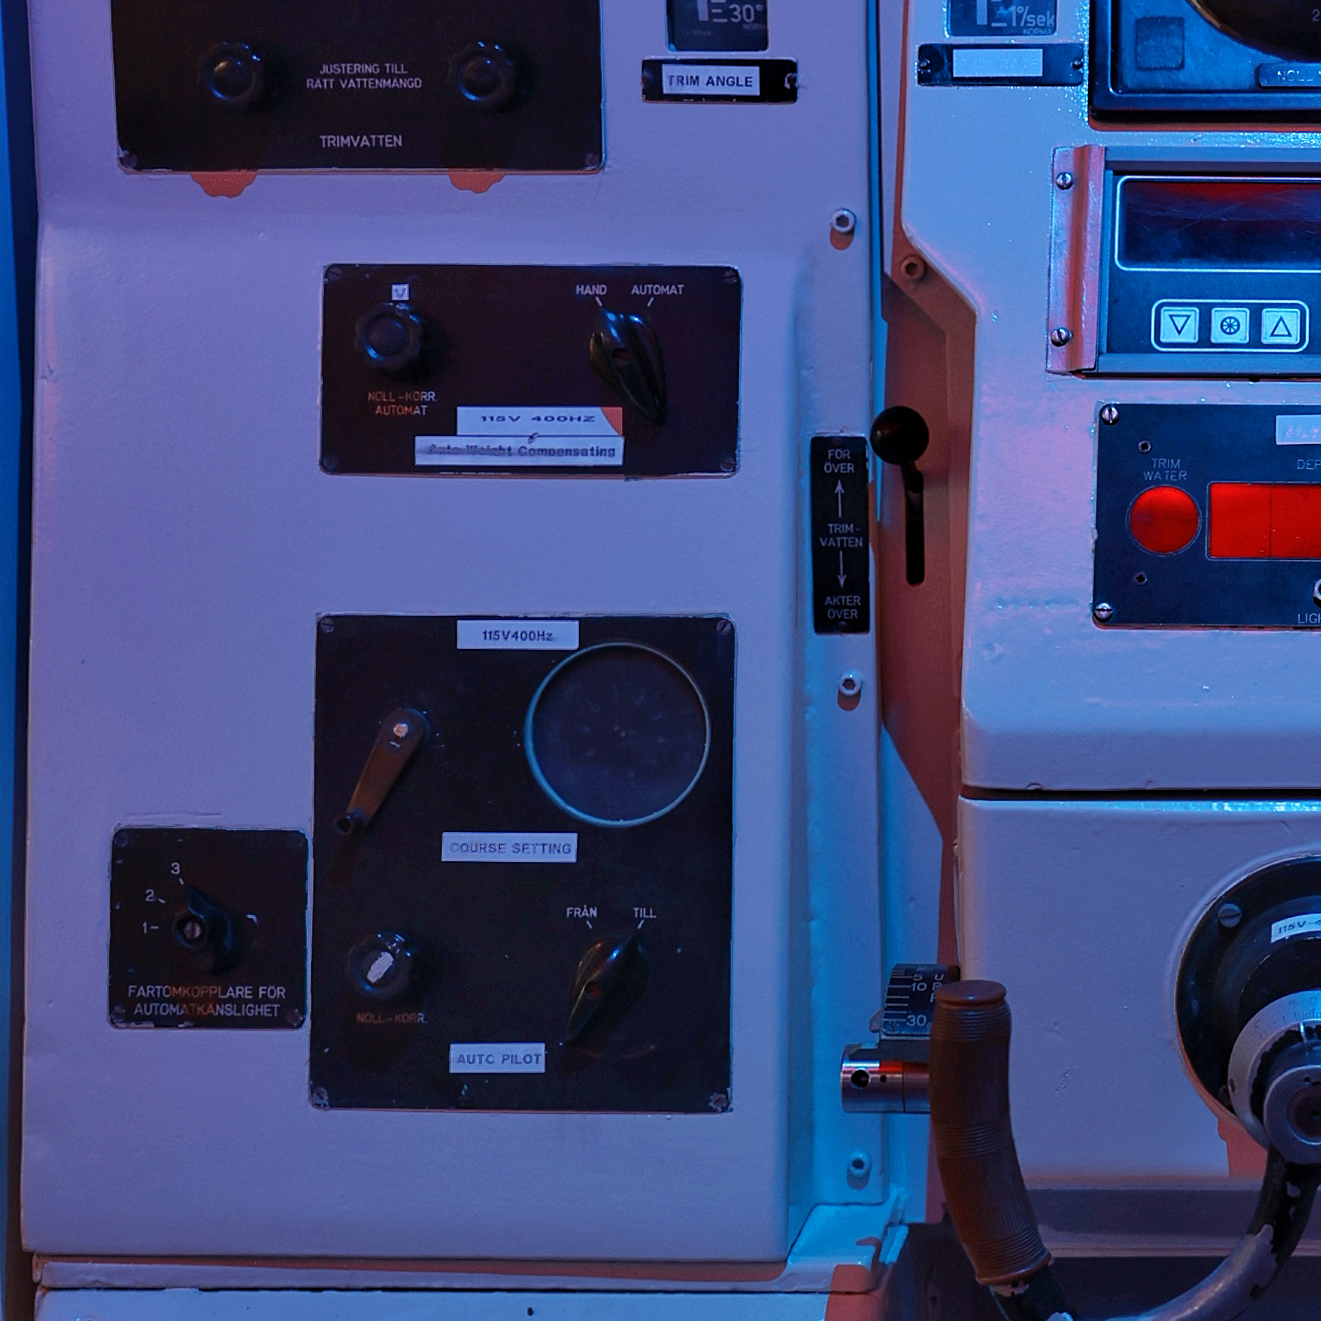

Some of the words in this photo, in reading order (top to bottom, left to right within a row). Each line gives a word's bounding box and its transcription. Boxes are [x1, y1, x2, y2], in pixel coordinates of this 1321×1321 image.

[320, 63, 381, 75] JUSTERING
[384, 63, 408, 74] TILL
[667, 74, 700, 87] TRIM
[705, 75, 753, 88] ANGLE
[319, 134, 402, 148] TRIMVATTEN
[576, 284, 607, 295] HAND
[631, 284, 684, 295] AUTOMAT
[375, 405, 428, 416] AUTOMAT
[530, 415, 596, 423] 400HZ
[518, 446, 616, 458] Compensating
[1151, 458, 1181, 469] TRIM
[1143, 470, 1187, 482] WATER
[819, 537, 863, 548] VATTEN
[824, 595, 862, 607] AKTER
[482, 630, 553, 642] 115V400Hz
[449, 842, 507, 854] COURSE
[511, 842, 572, 855] SETTING
[171, 861, 181, 874] 3
[145, 889, 156, 902] 2
[566, 904, 598, 919] FRÅN
[633, 907, 657, 919] TILL
[128, 985, 253, 999] FARTOMKOPPLARE
[906, 1015, 927, 1026] 30
[501, 1053, 542, 1065] PILOT
